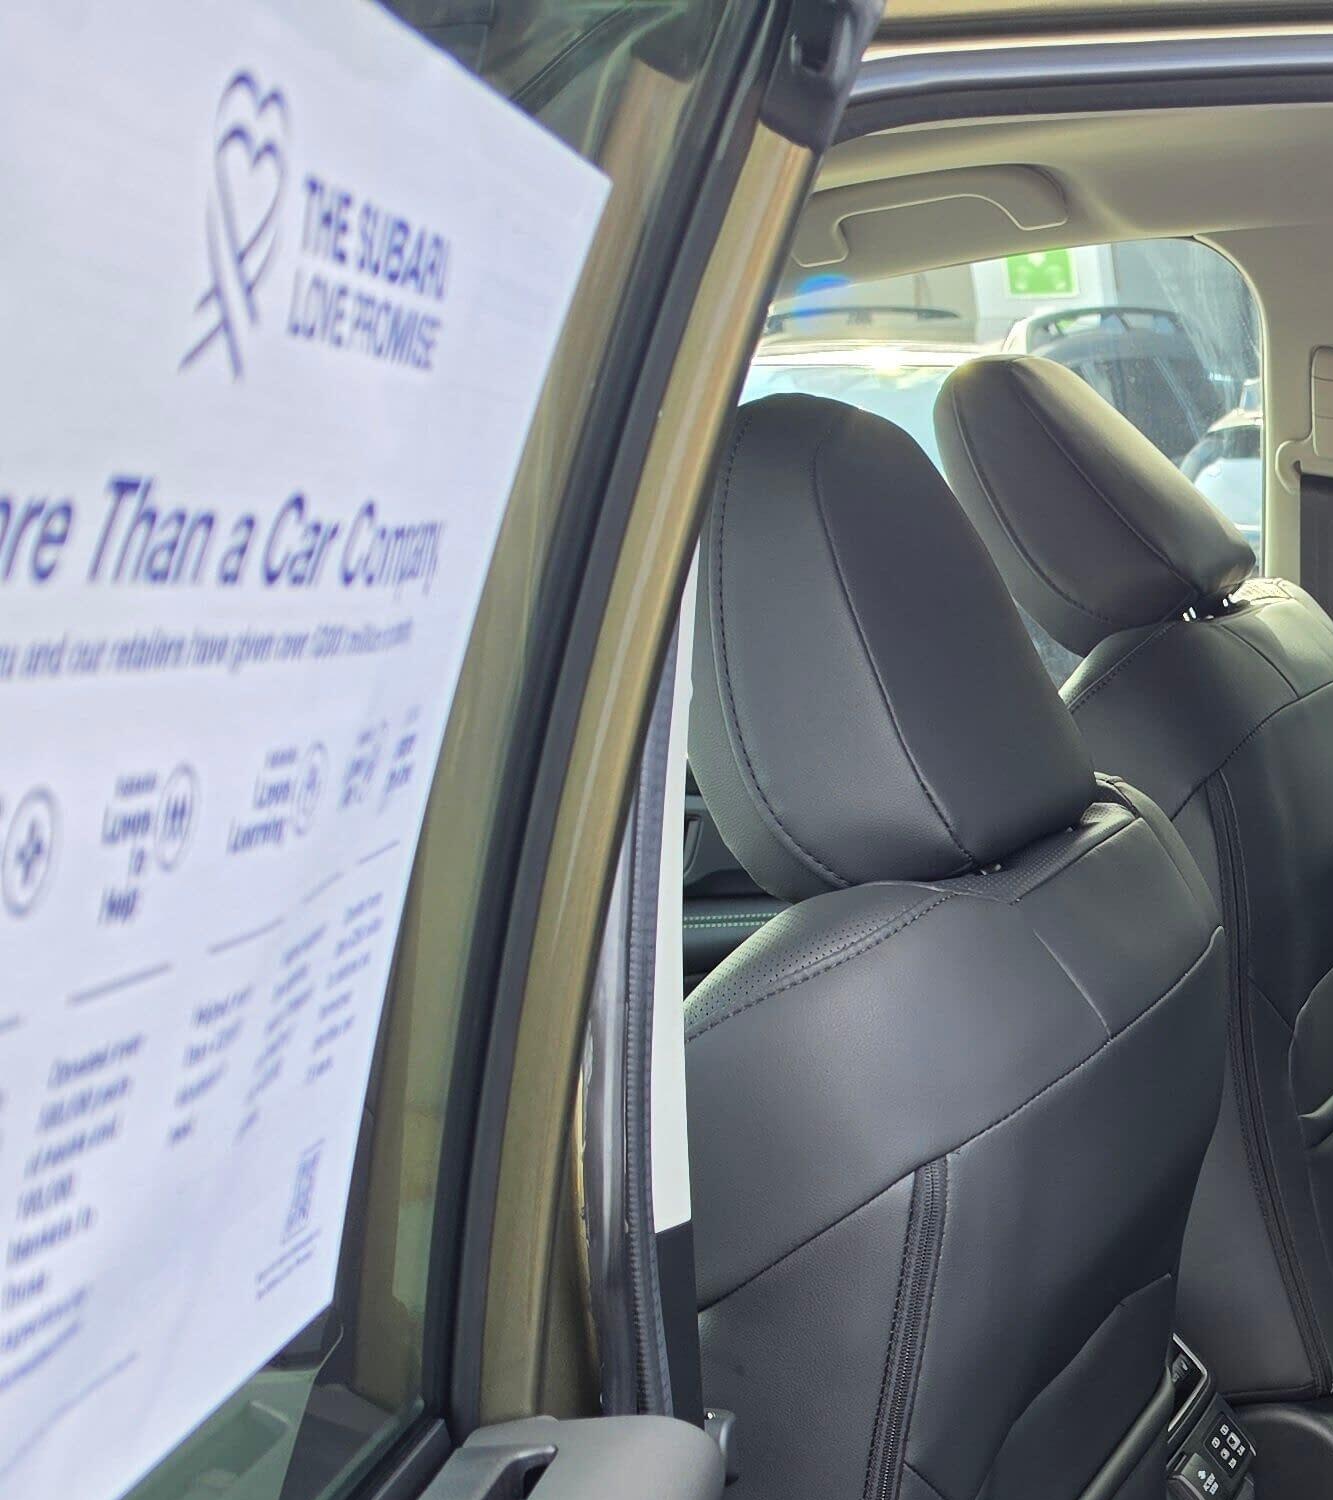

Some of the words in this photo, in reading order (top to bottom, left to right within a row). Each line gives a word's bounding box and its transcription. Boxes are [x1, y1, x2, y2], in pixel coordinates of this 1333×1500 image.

[303, 174, 353, 264] THE
[87, 475, 216, 587] Than
[218, 512, 256, 586] a
[260, 490, 340, 587] Car
